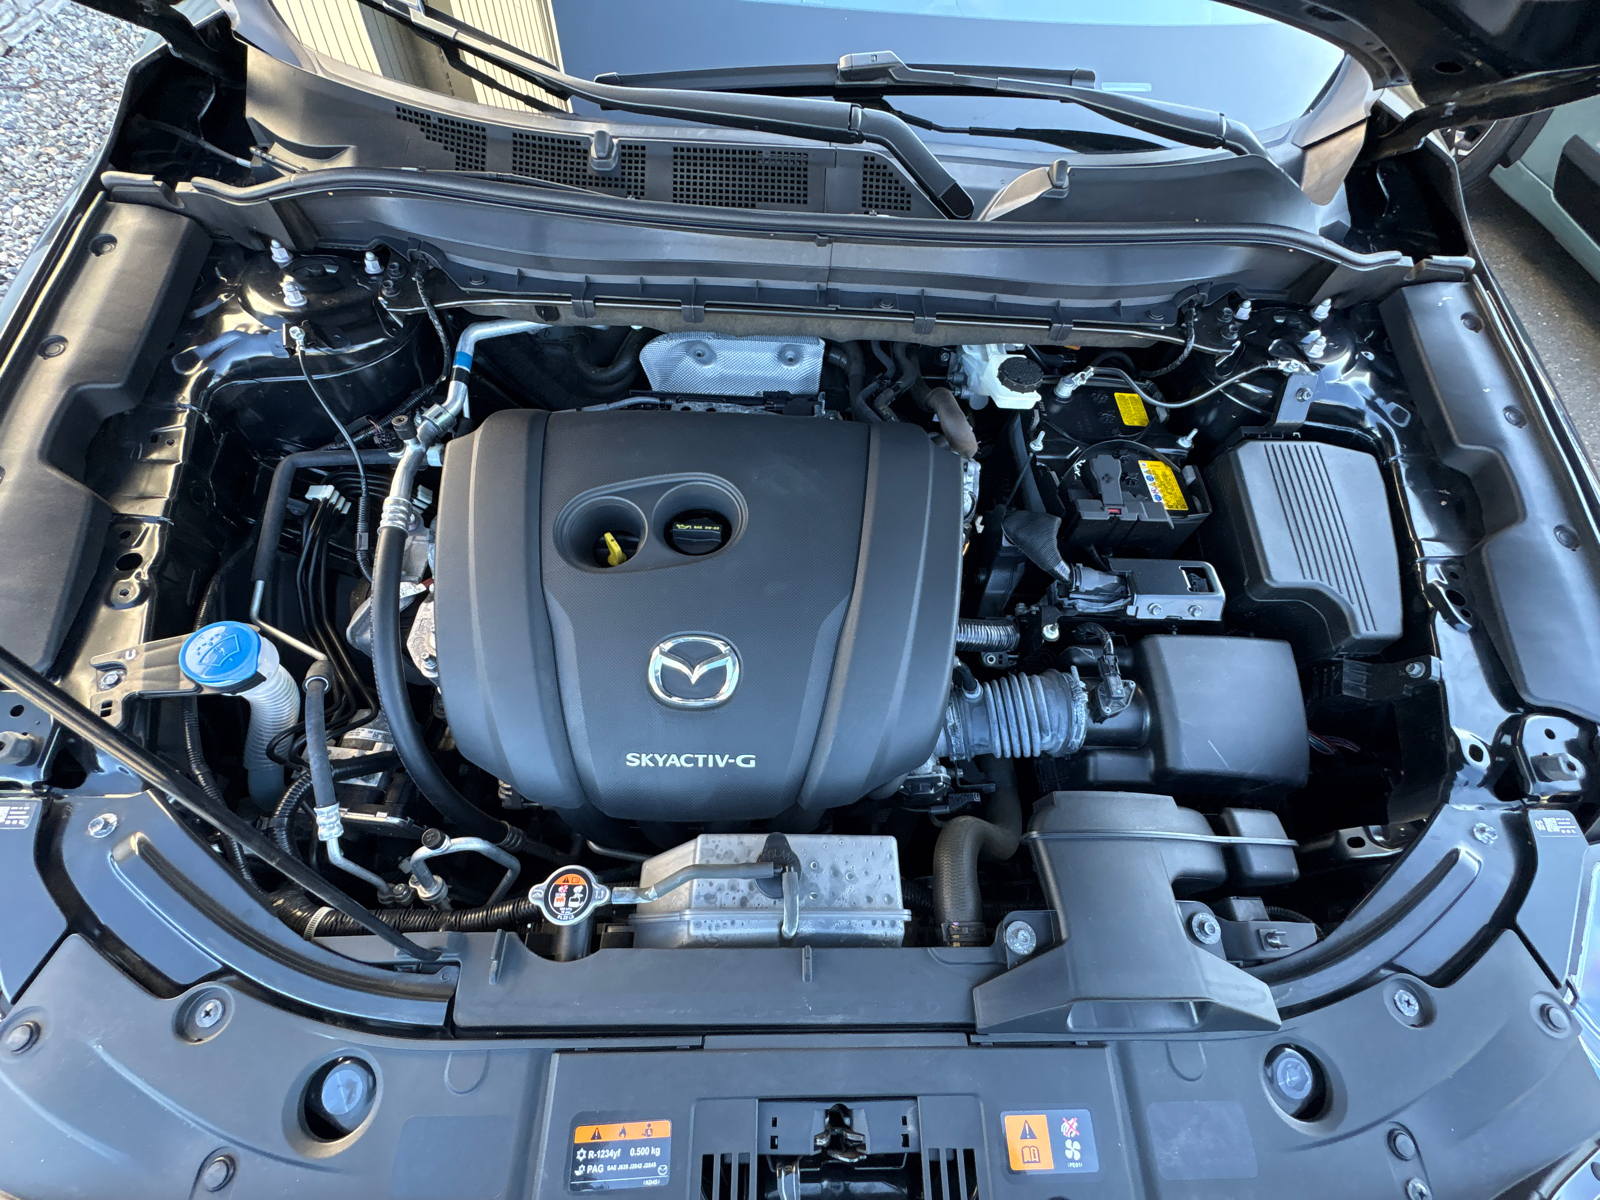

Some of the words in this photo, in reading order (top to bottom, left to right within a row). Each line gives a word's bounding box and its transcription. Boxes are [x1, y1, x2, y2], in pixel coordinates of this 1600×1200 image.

[626, 752, 756, 768] SKYACTIV-G
[588, 1148, 621, 1160] R-1234yf
[630, 1147, 650, 1157] 0.500
[651, 1146, 660, 1157] kg
[586, 1164, 604, 1174] PAG
